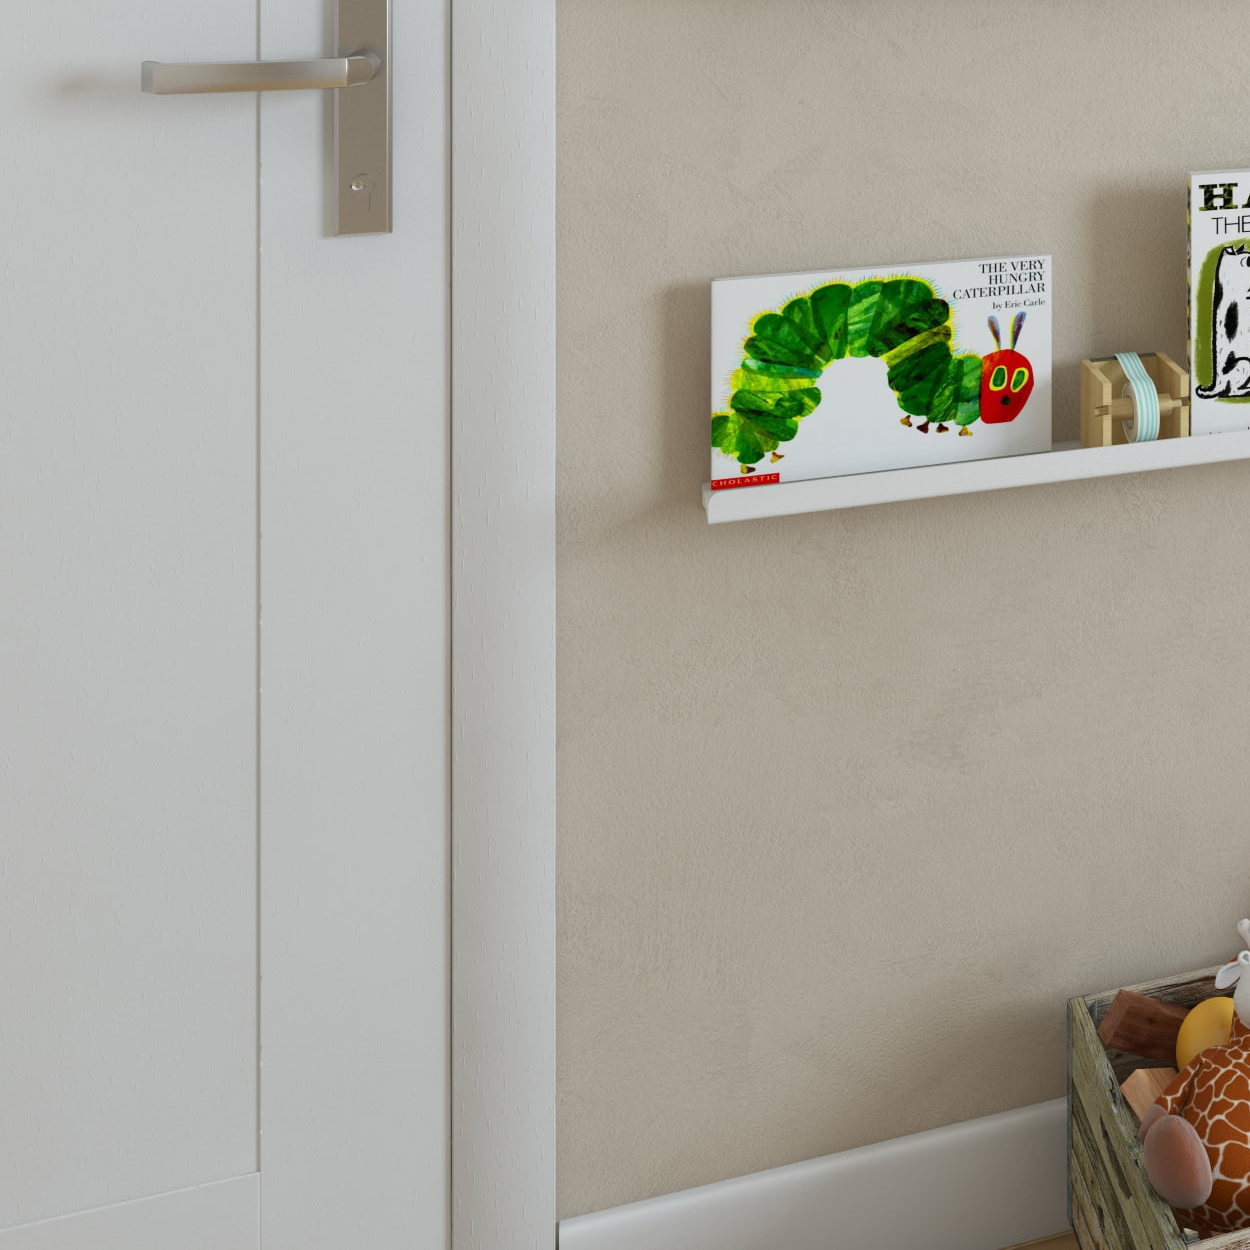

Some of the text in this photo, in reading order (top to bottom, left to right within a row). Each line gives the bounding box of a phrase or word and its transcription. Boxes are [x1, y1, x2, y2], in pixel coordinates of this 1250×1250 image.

[978, 258, 1045, 274] THE VERY
[989, 271, 1046, 285] HUNGRY
[952, 283, 1046, 299] CATERPILLAR
[992, 298, 1046, 311] by Eric Carle
[712, 474, 778, 487] CHOLASTIC
